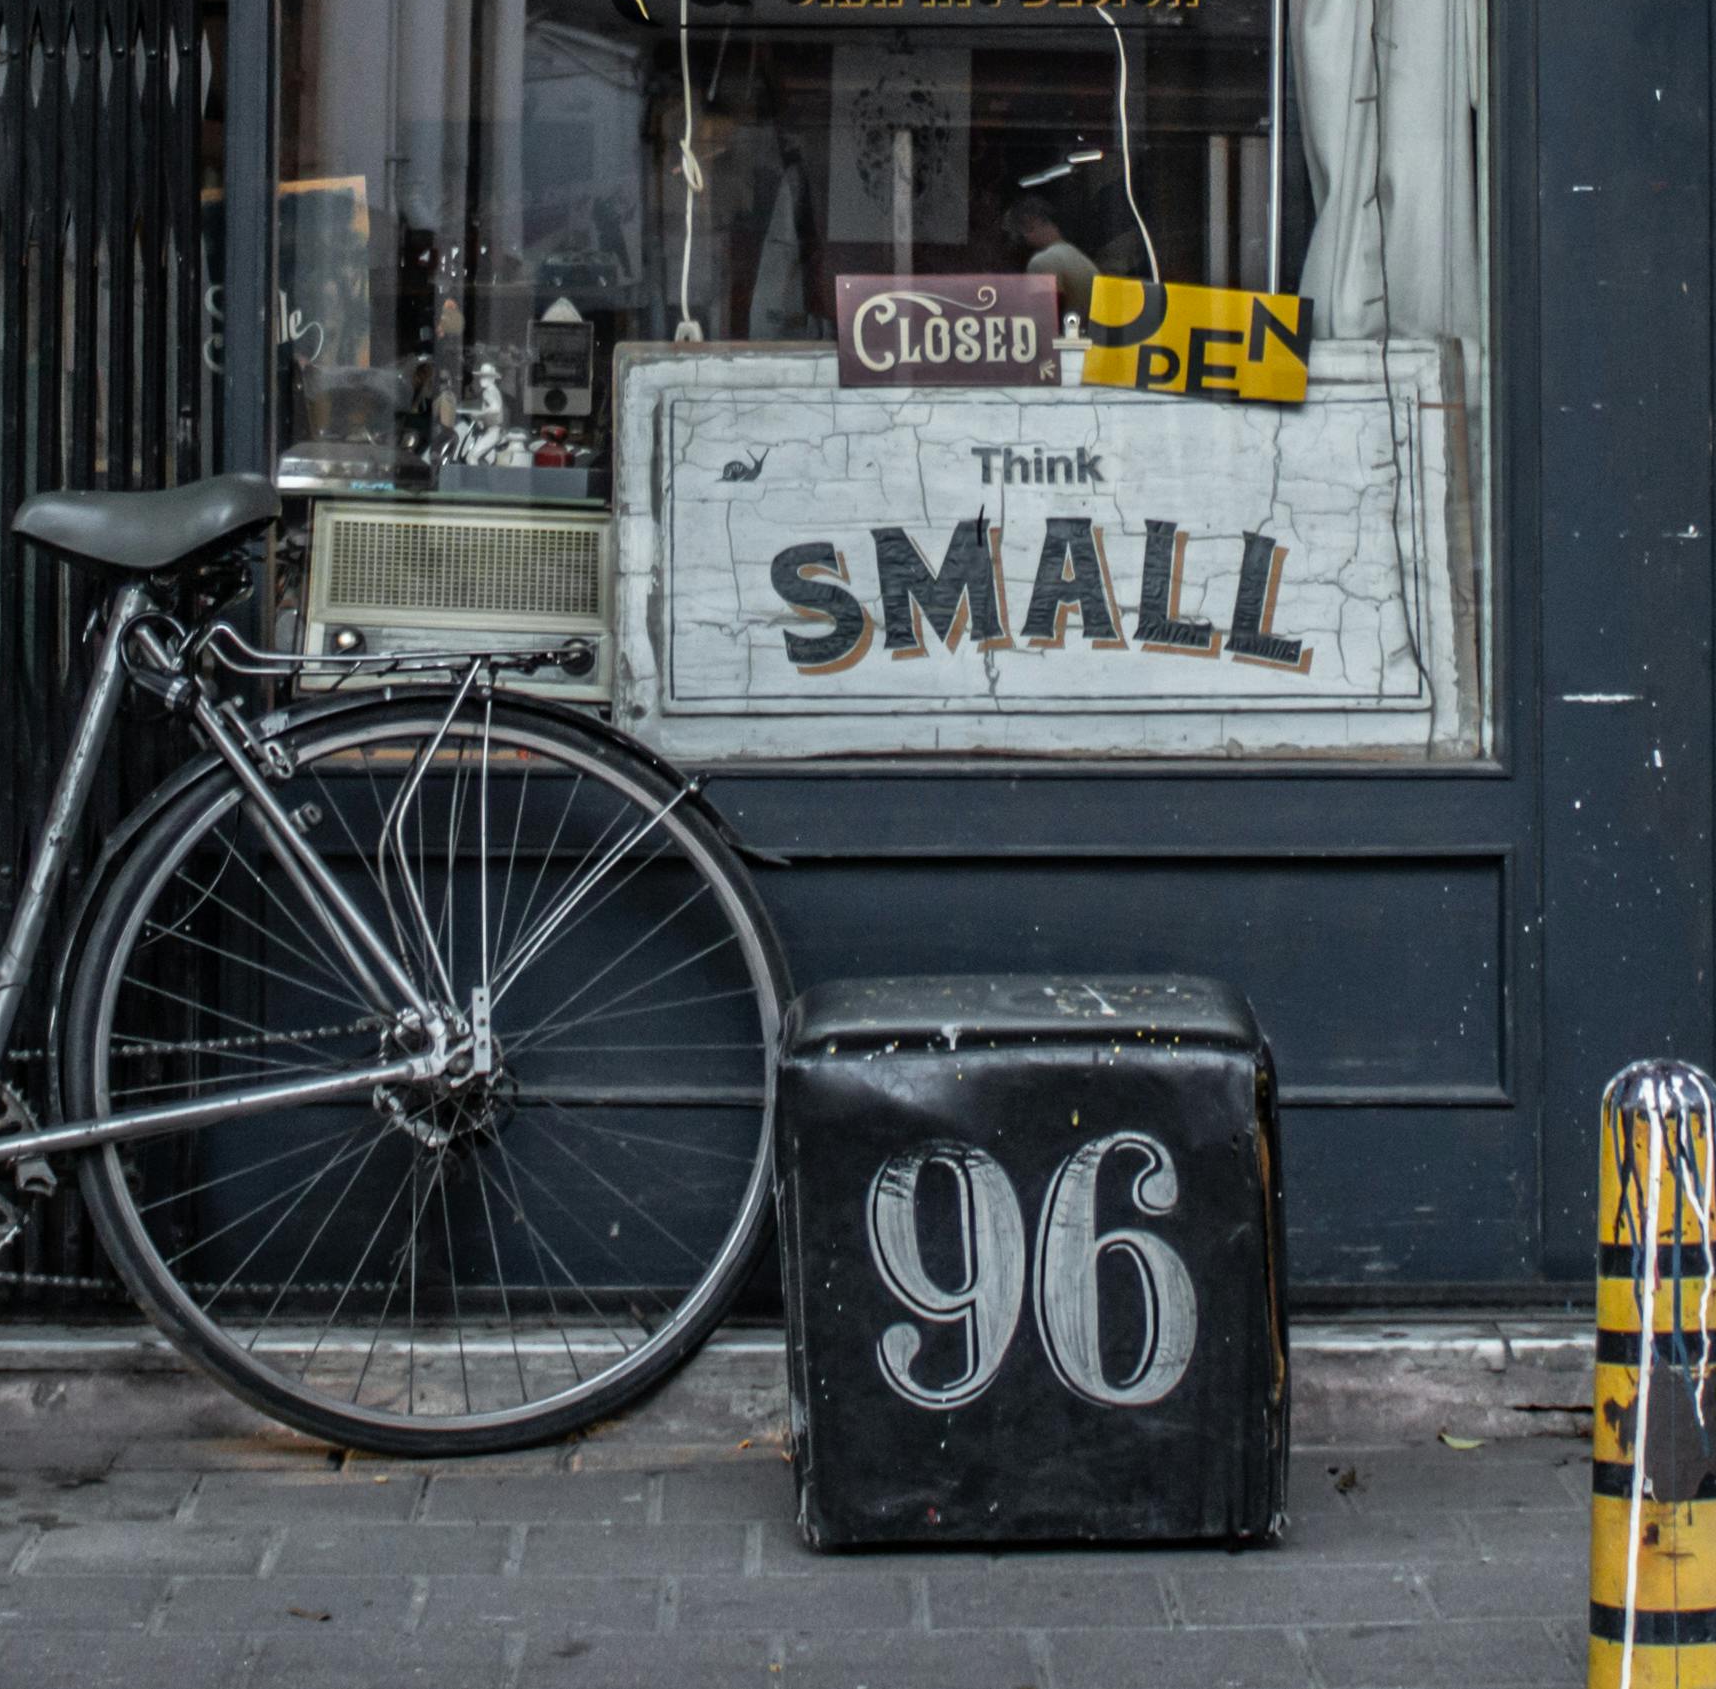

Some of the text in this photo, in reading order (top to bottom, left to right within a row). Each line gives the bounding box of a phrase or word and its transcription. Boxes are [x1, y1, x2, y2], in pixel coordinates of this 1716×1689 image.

[971, 446, 1104, 486] Think
[770, 518, 1315, 676] SMALL
[866, 1130, 1199, 1410] 96
